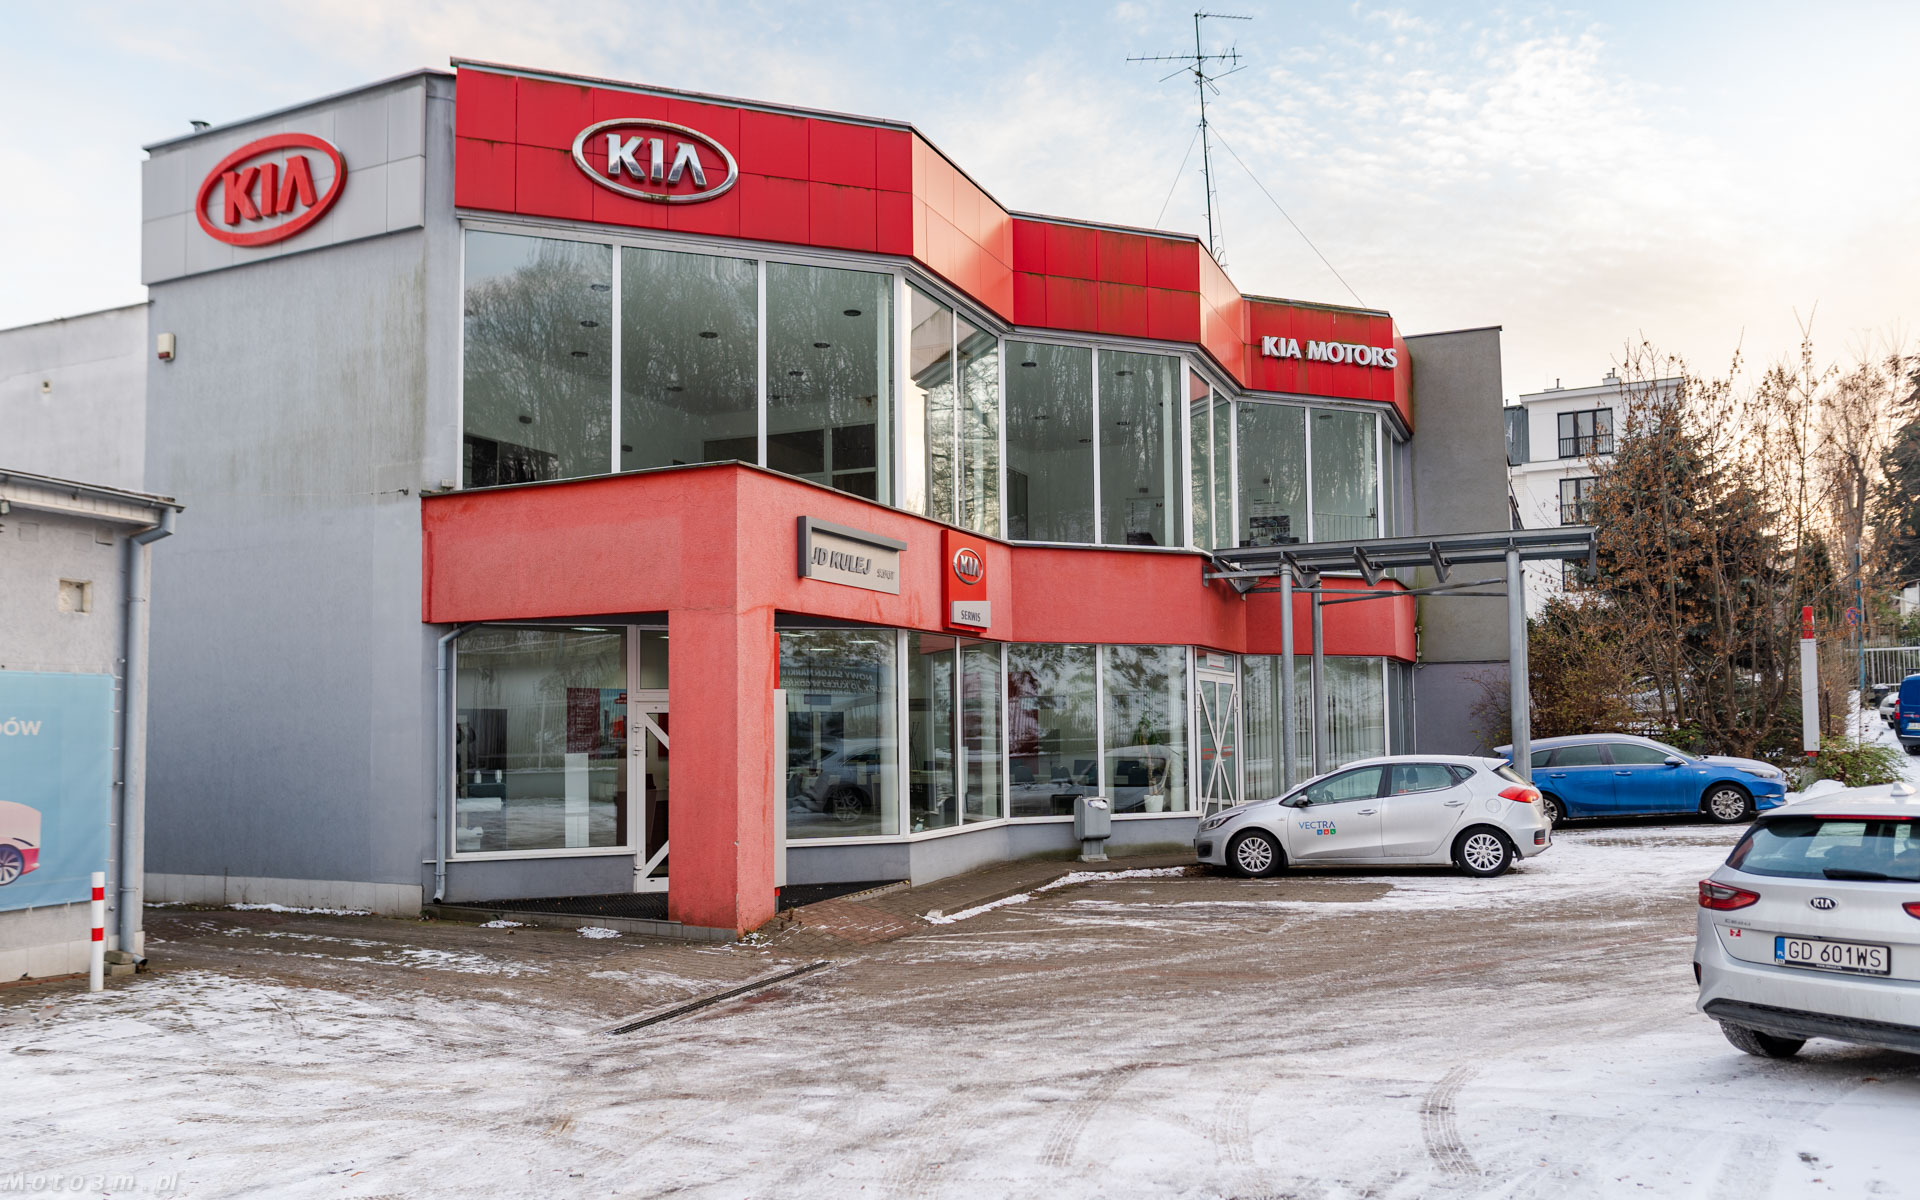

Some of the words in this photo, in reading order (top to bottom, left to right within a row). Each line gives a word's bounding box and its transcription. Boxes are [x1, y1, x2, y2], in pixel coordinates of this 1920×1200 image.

[605, 133, 707, 187] KIA
[221, 155, 319, 226] KIA
[1262, 336, 1302, 359] KIA
[1306, 340, 1398, 368] MOTORS
[811, 547, 828, 566] JD
[830, 551, 872, 575] KULEJ
[960, 554, 980, 577] KIA
[961, 609, 981, 622] SERWIS
[0, 716, 43, 736] ÓW
[1299, 820, 1336, 829] VECTRA
[1813, 899, 1833, 908] KIA
[1789, 941, 1813, 960] GD
[1820, 944, 1881, 968] 601WS
